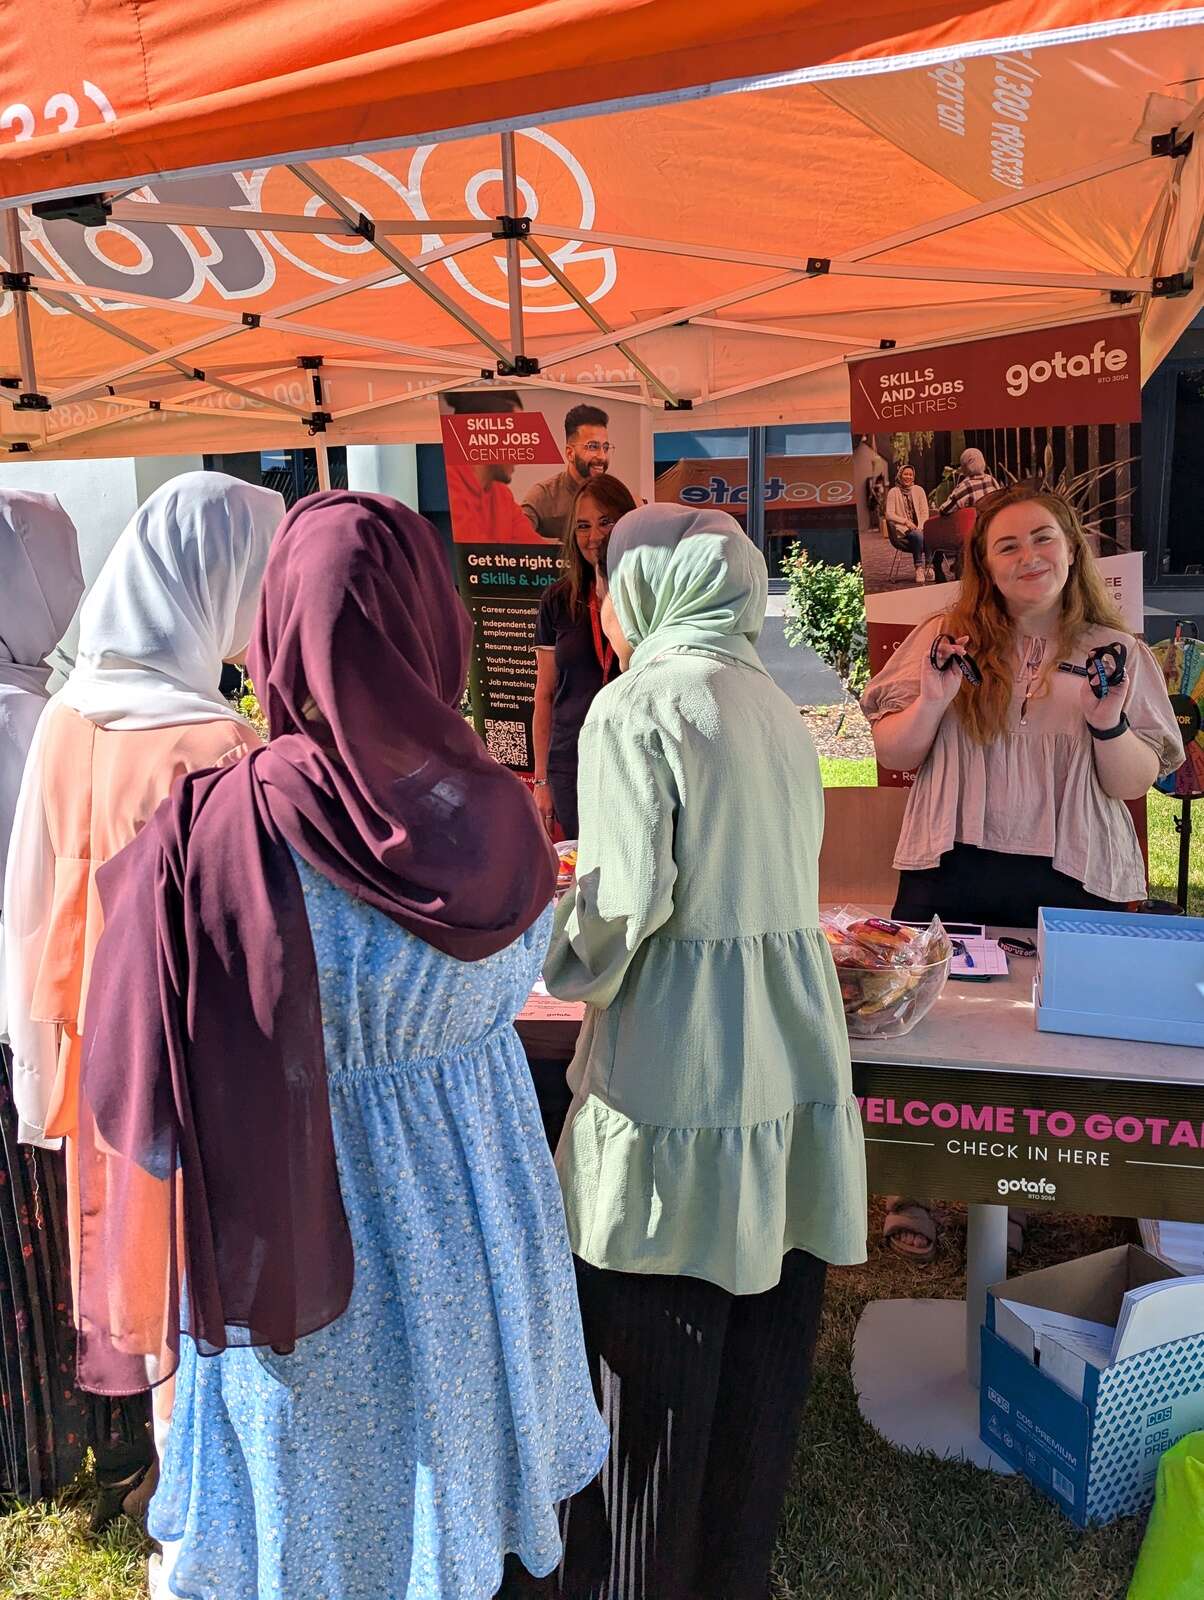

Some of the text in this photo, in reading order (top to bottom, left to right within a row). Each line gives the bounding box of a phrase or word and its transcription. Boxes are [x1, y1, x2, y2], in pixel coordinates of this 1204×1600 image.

[1005, 340, 1128, 397] gotafe
[879, 367, 935, 388] SKILLS
[880, 379, 965, 404] AND JOBS
[881, 396, 958, 420] CENTRES
[466, 417, 514, 431] SKILLS
[468, 432, 541, 446] AND JOBS
[469, 448, 536, 461] CENTRES
[467, 554, 493, 567] Get
[494, 555, 517, 567] the
[519, 555, 553, 571] right
[469, 574, 479, 584] a
[481, 572, 516, 586] Skills
[518, 574, 530, 586] &
[482, 620, 527, 630] Independent
[483, 630, 527, 638] employment
[484, 643, 512, 651] Resume
[512, 644, 527, 652] and
[486, 656, 536, 666] Youth-focused
[487, 665, 515, 675] training
[502, 680, 536, 690] matching
[489, 692, 516, 701] Welfare
[490, 701, 520, 709] referrals
[856, 1096, 1204, 1149] ELCOME TO GOTA
[946, 1139, 1111, 1167] CHECK IN HERE
[997, 1177, 1057, 1196] gotafe
[1148, 1407, 1172, 1427] COS
[1144, 1428, 1170, 1446] COS
[1035, 1425, 1077, 1467] PREMIUM
[1143, 1434, 1184, 1458] PREM
